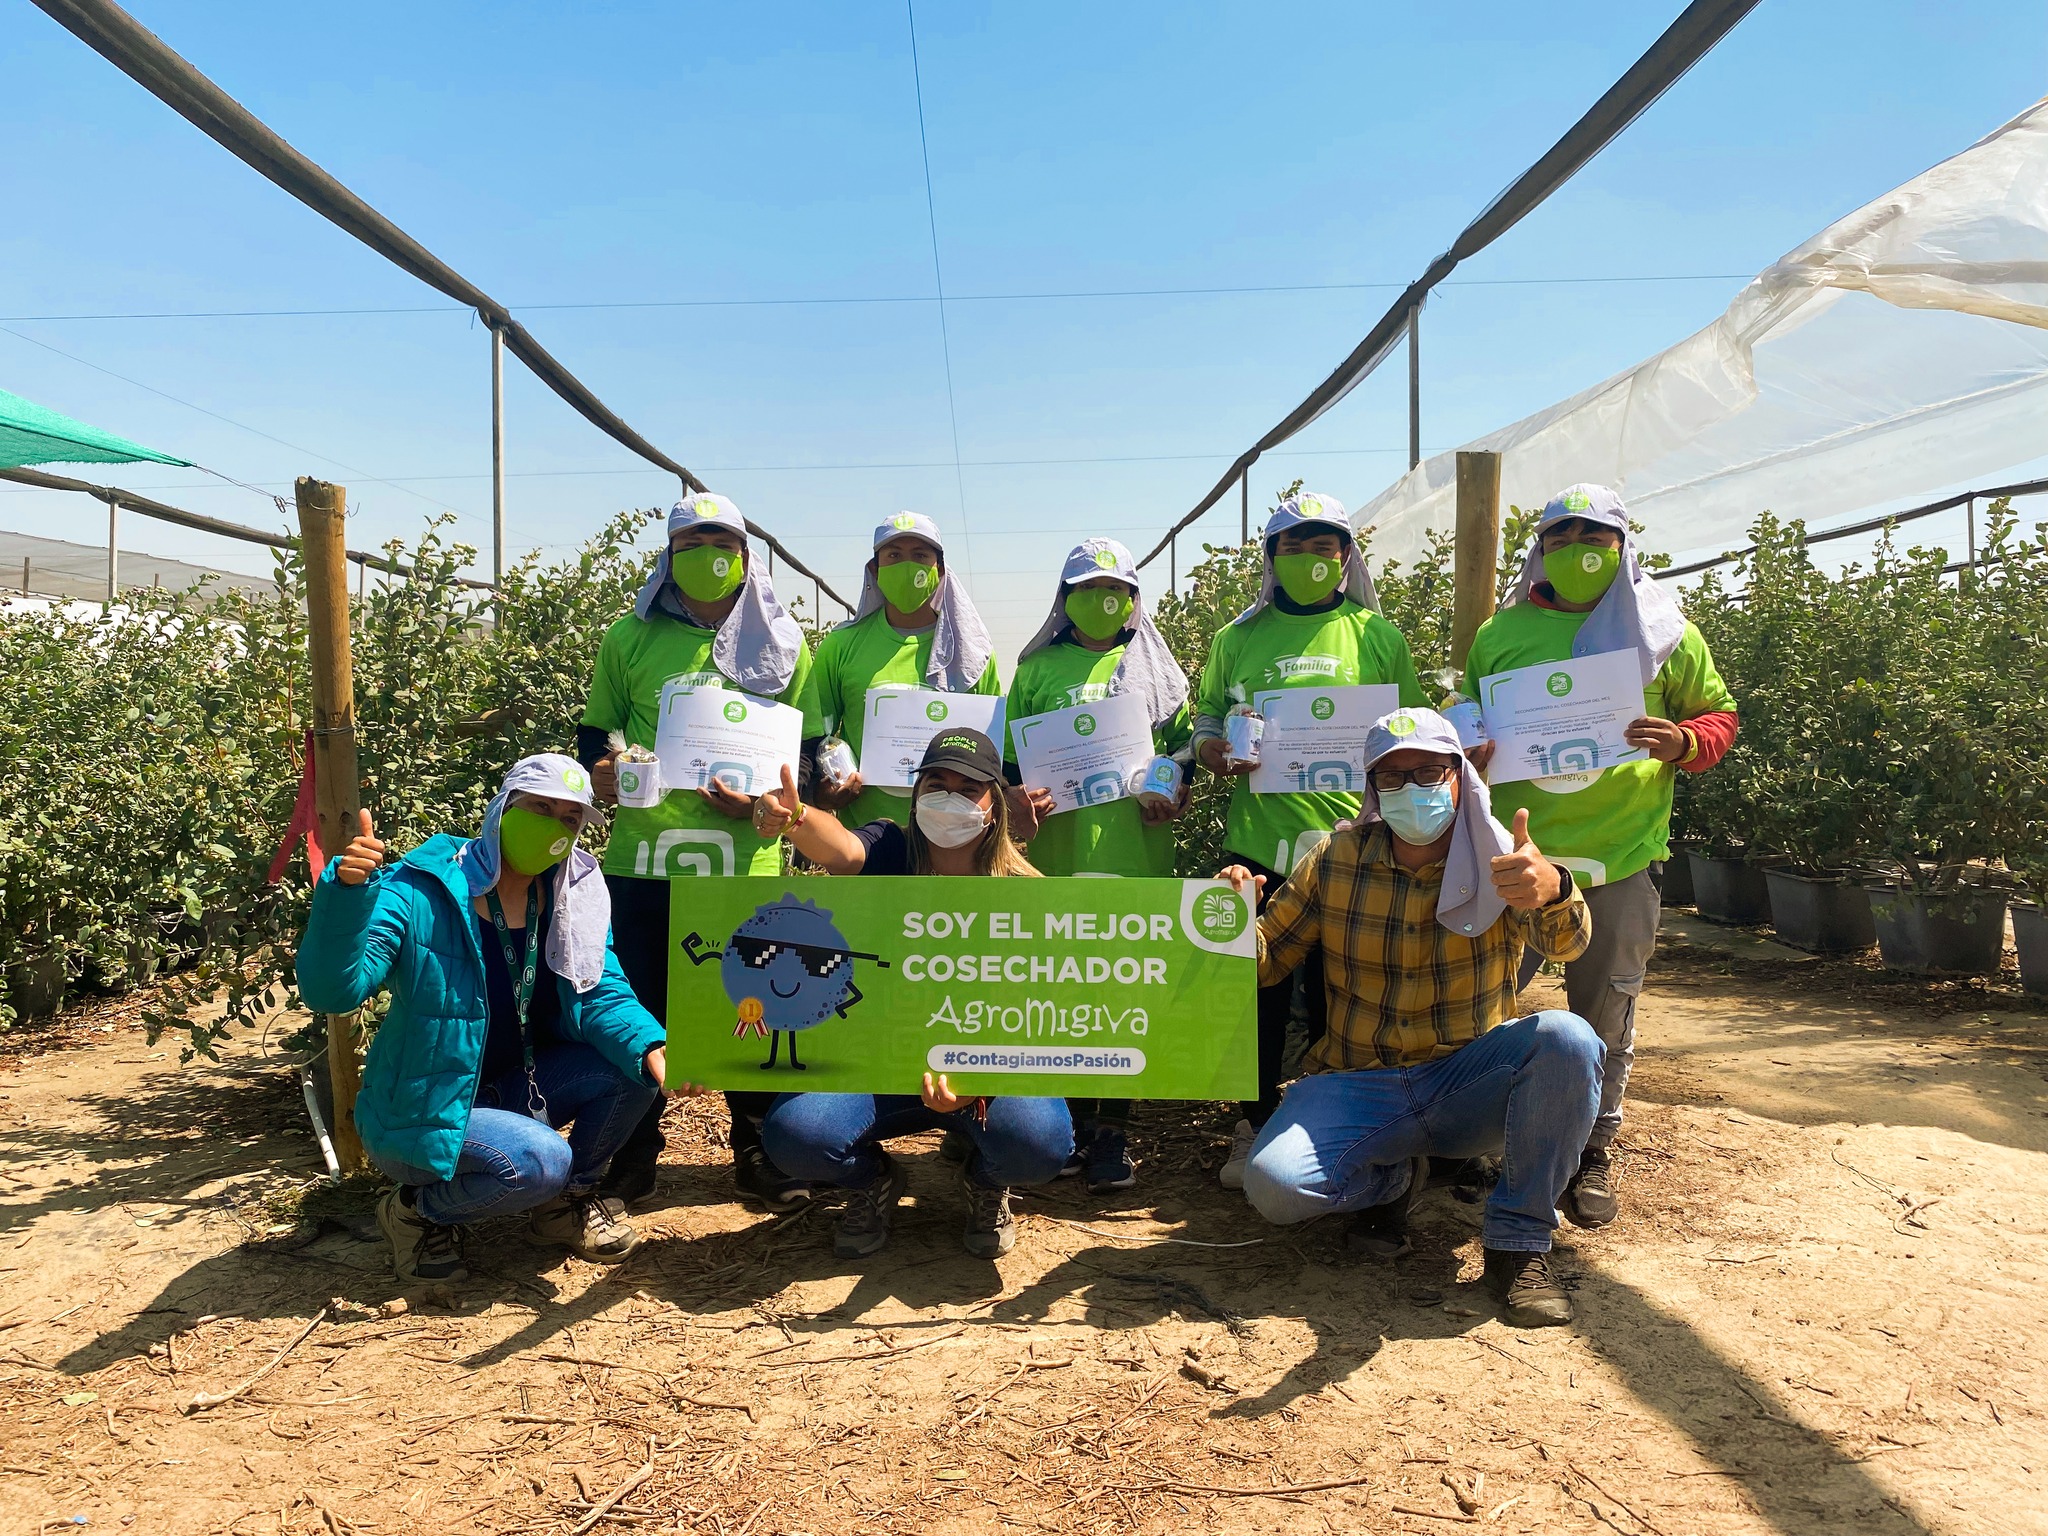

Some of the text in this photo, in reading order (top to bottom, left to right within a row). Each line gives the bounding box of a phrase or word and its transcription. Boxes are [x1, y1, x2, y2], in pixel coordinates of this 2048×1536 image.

[1285, 660, 1332, 673] Familia
[1561, 699, 1591, 708] COSECHADOR
[943, 735, 978, 748] PEOPLE
[902, 911, 1174, 941] SOY EL MEJOR
[902, 954, 1168, 985] COSECHADOR
[943, 1051, 1131, 1069] #ContagiamosPasión
